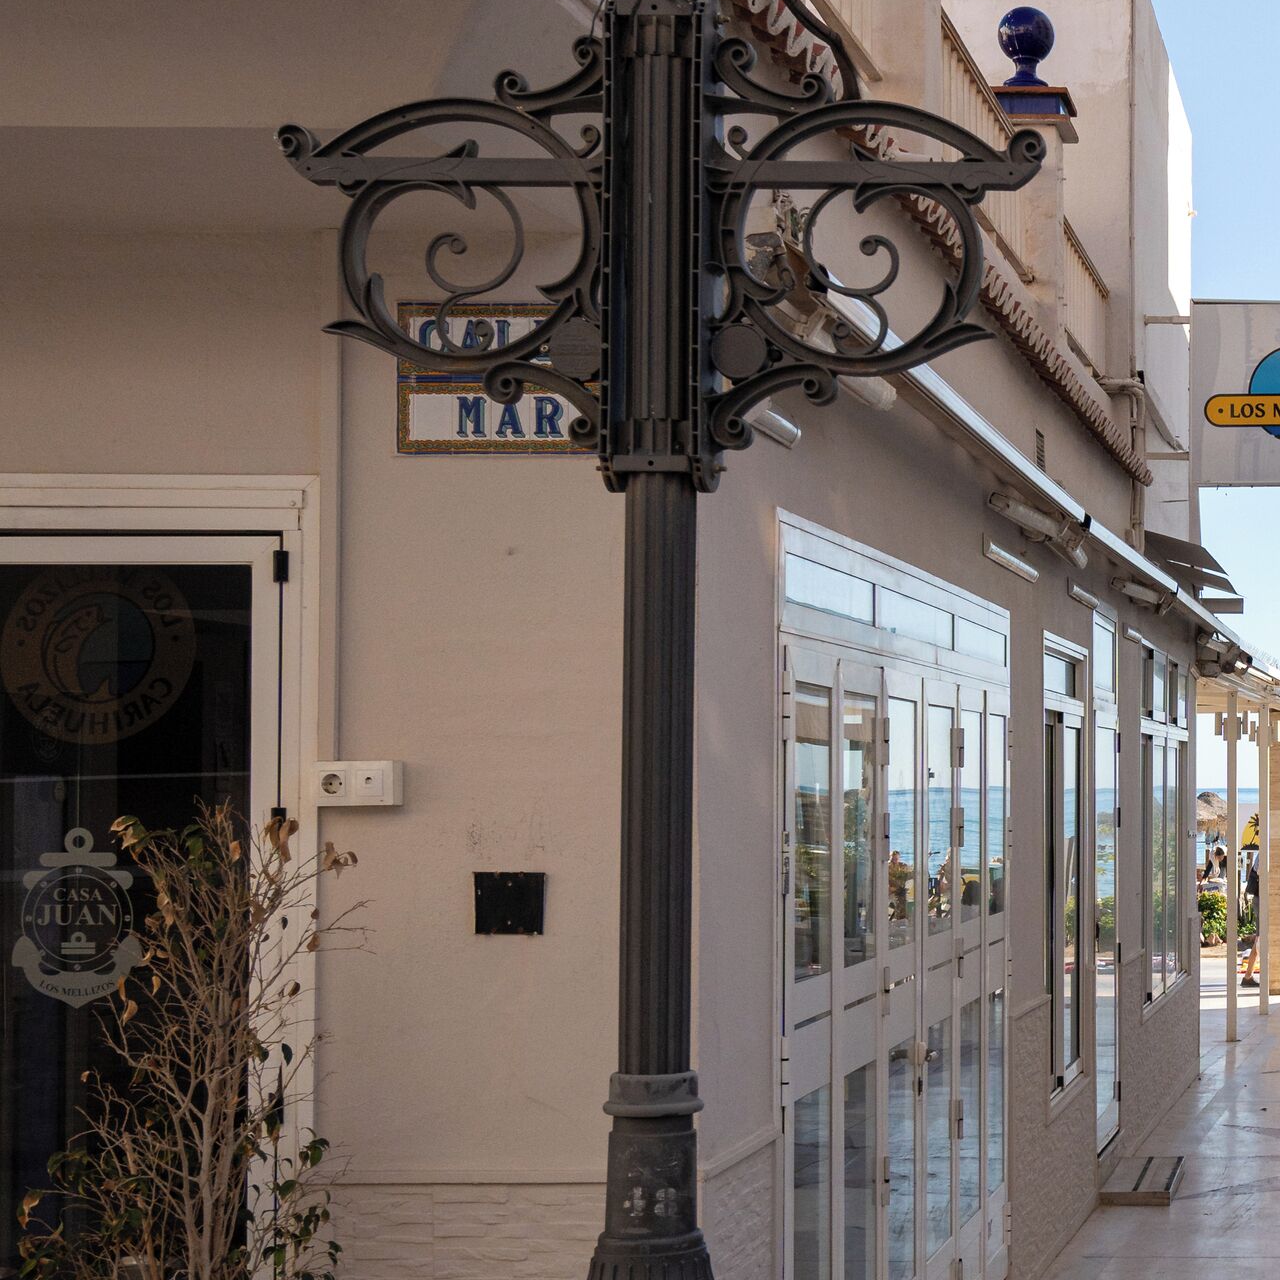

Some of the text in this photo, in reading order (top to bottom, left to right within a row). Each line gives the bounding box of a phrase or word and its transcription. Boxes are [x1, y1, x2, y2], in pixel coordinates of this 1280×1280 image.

[457, 396, 564, 438] MAR
[1230, 402, 1266, 418] LOS
[53, 887, 103, 902] CASA
[37, 904, 118, 926] JUAN
[40, 979, 116, 997] LOS MELLIZOS
